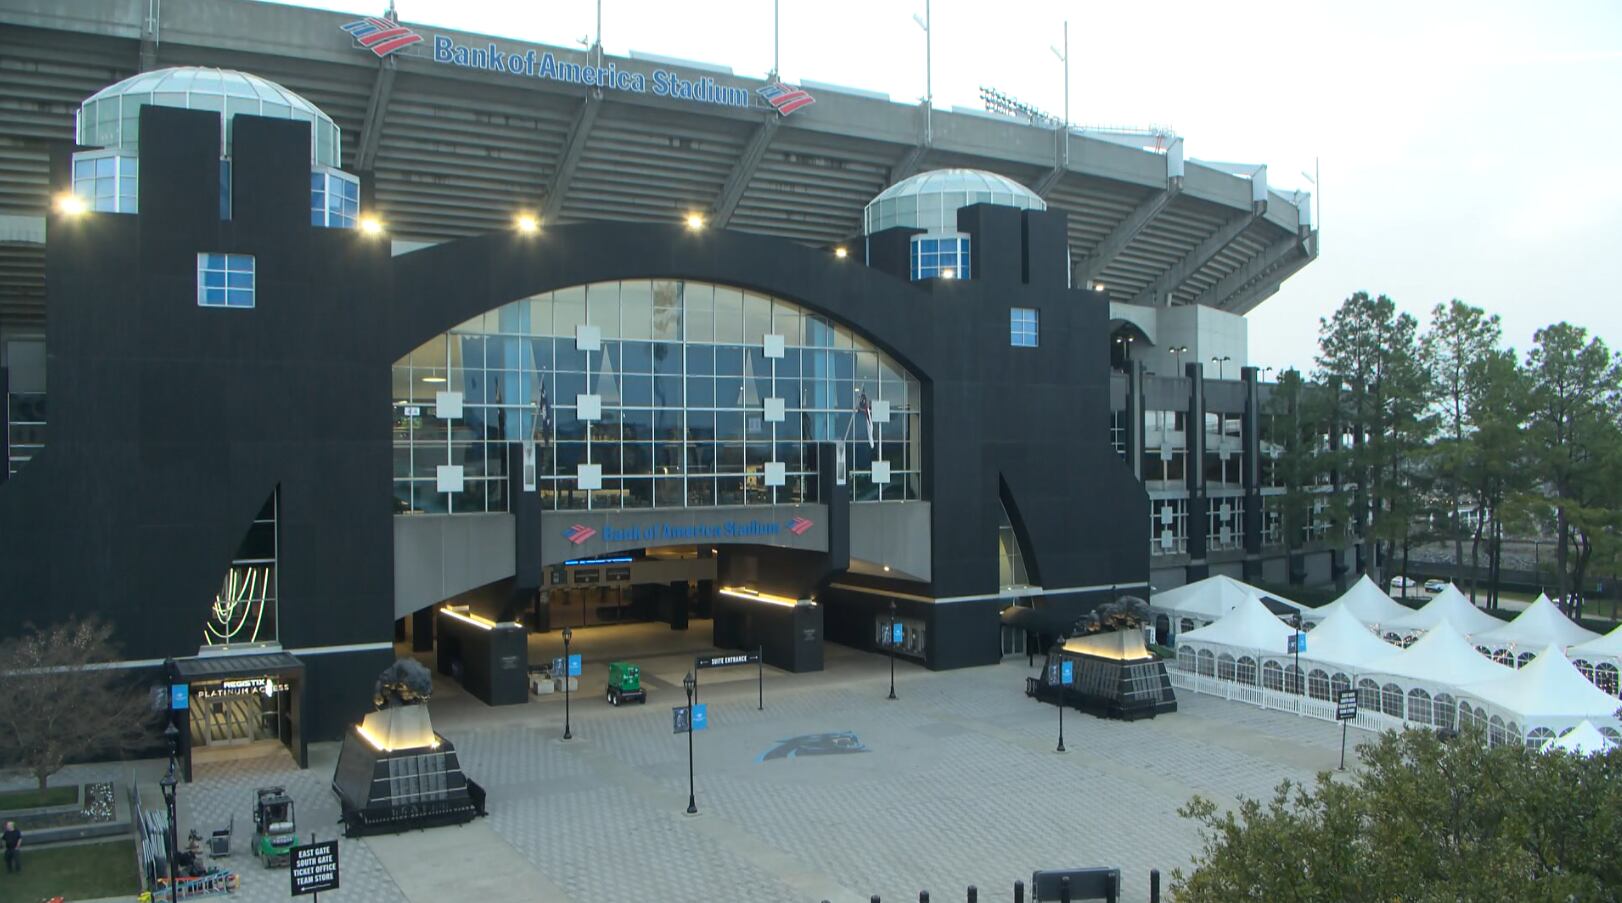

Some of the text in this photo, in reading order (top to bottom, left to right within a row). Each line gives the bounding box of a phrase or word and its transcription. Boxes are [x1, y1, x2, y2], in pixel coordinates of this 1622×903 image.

[434, 34, 749, 107] Bank of America Stadium
[604, 519, 780, 541] Bank of America Stadium
[198, 683, 289, 698] PLATINUM ACESS
[299, 846, 330, 858] EAST GATE
[296, 855, 333, 867] SOUTH GATE
[294, 864, 336, 876] TICKET OFFICE
[297, 873, 333, 885] TEAM STORE
